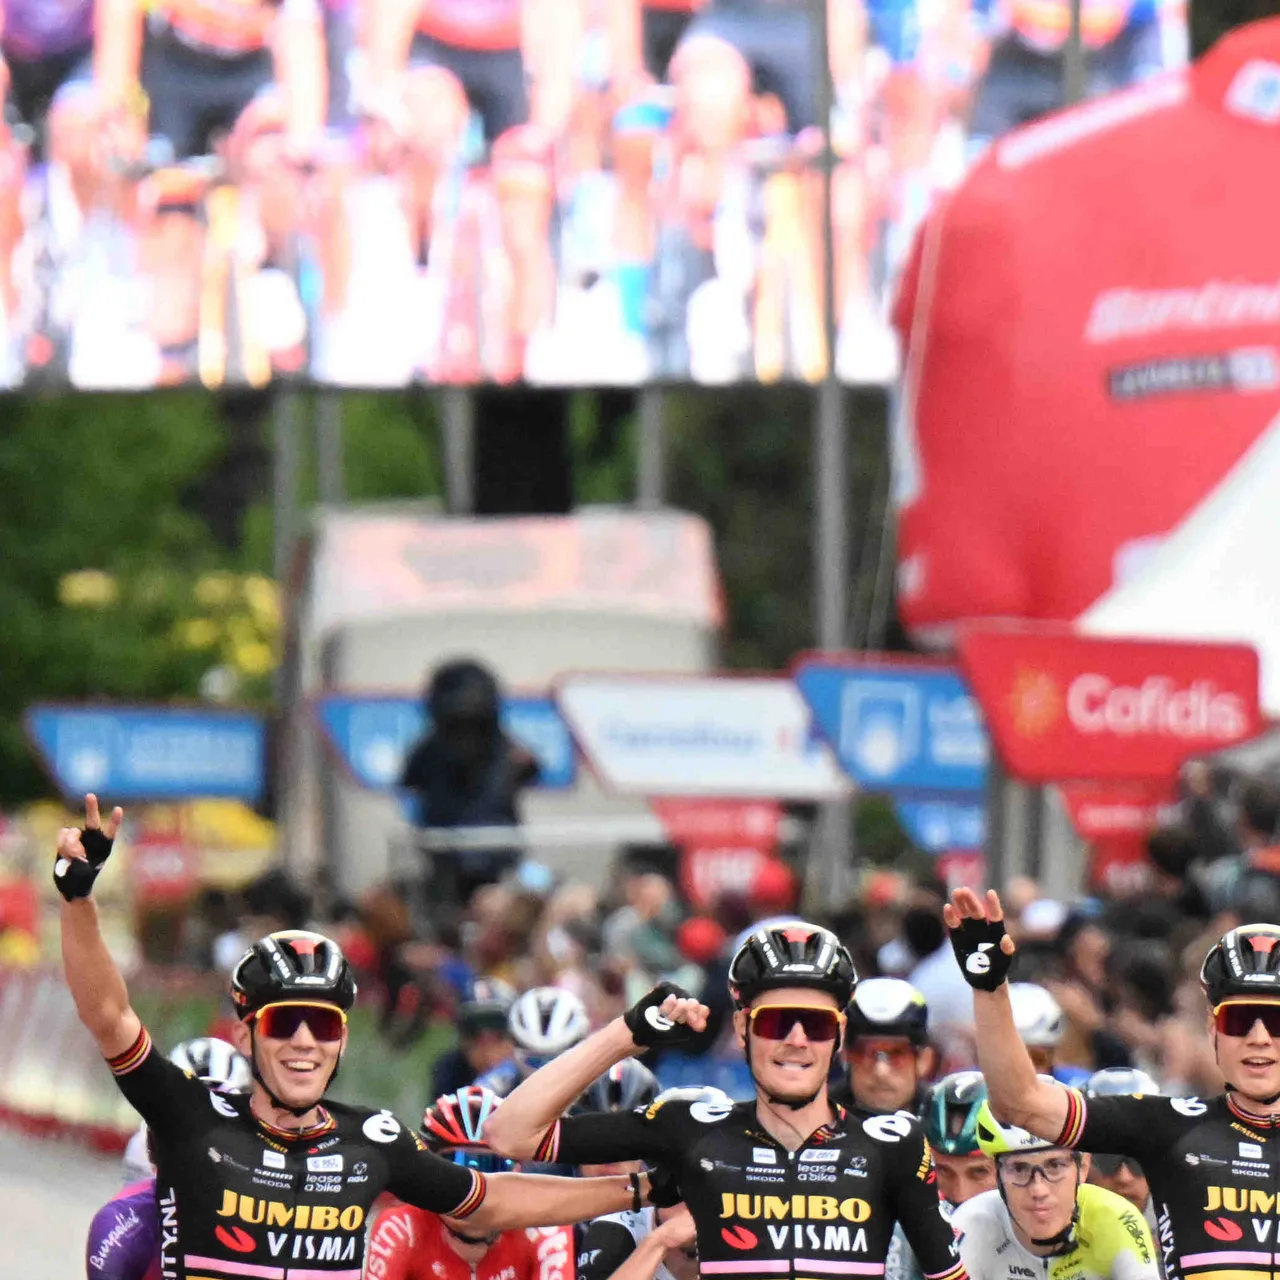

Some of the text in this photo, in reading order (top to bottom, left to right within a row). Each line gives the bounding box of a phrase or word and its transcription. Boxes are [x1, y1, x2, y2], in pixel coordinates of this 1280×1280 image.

[306, 1174, 342, 1183] lease
[798, 1163, 836, 1173] lease
[216, 1189, 363, 1231] JUMBO
[719, 1192, 871, 1222] JUMBO
[267, 1231, 355, 1261] VISMA
[767, 1224, 868, 1252] VISMA
